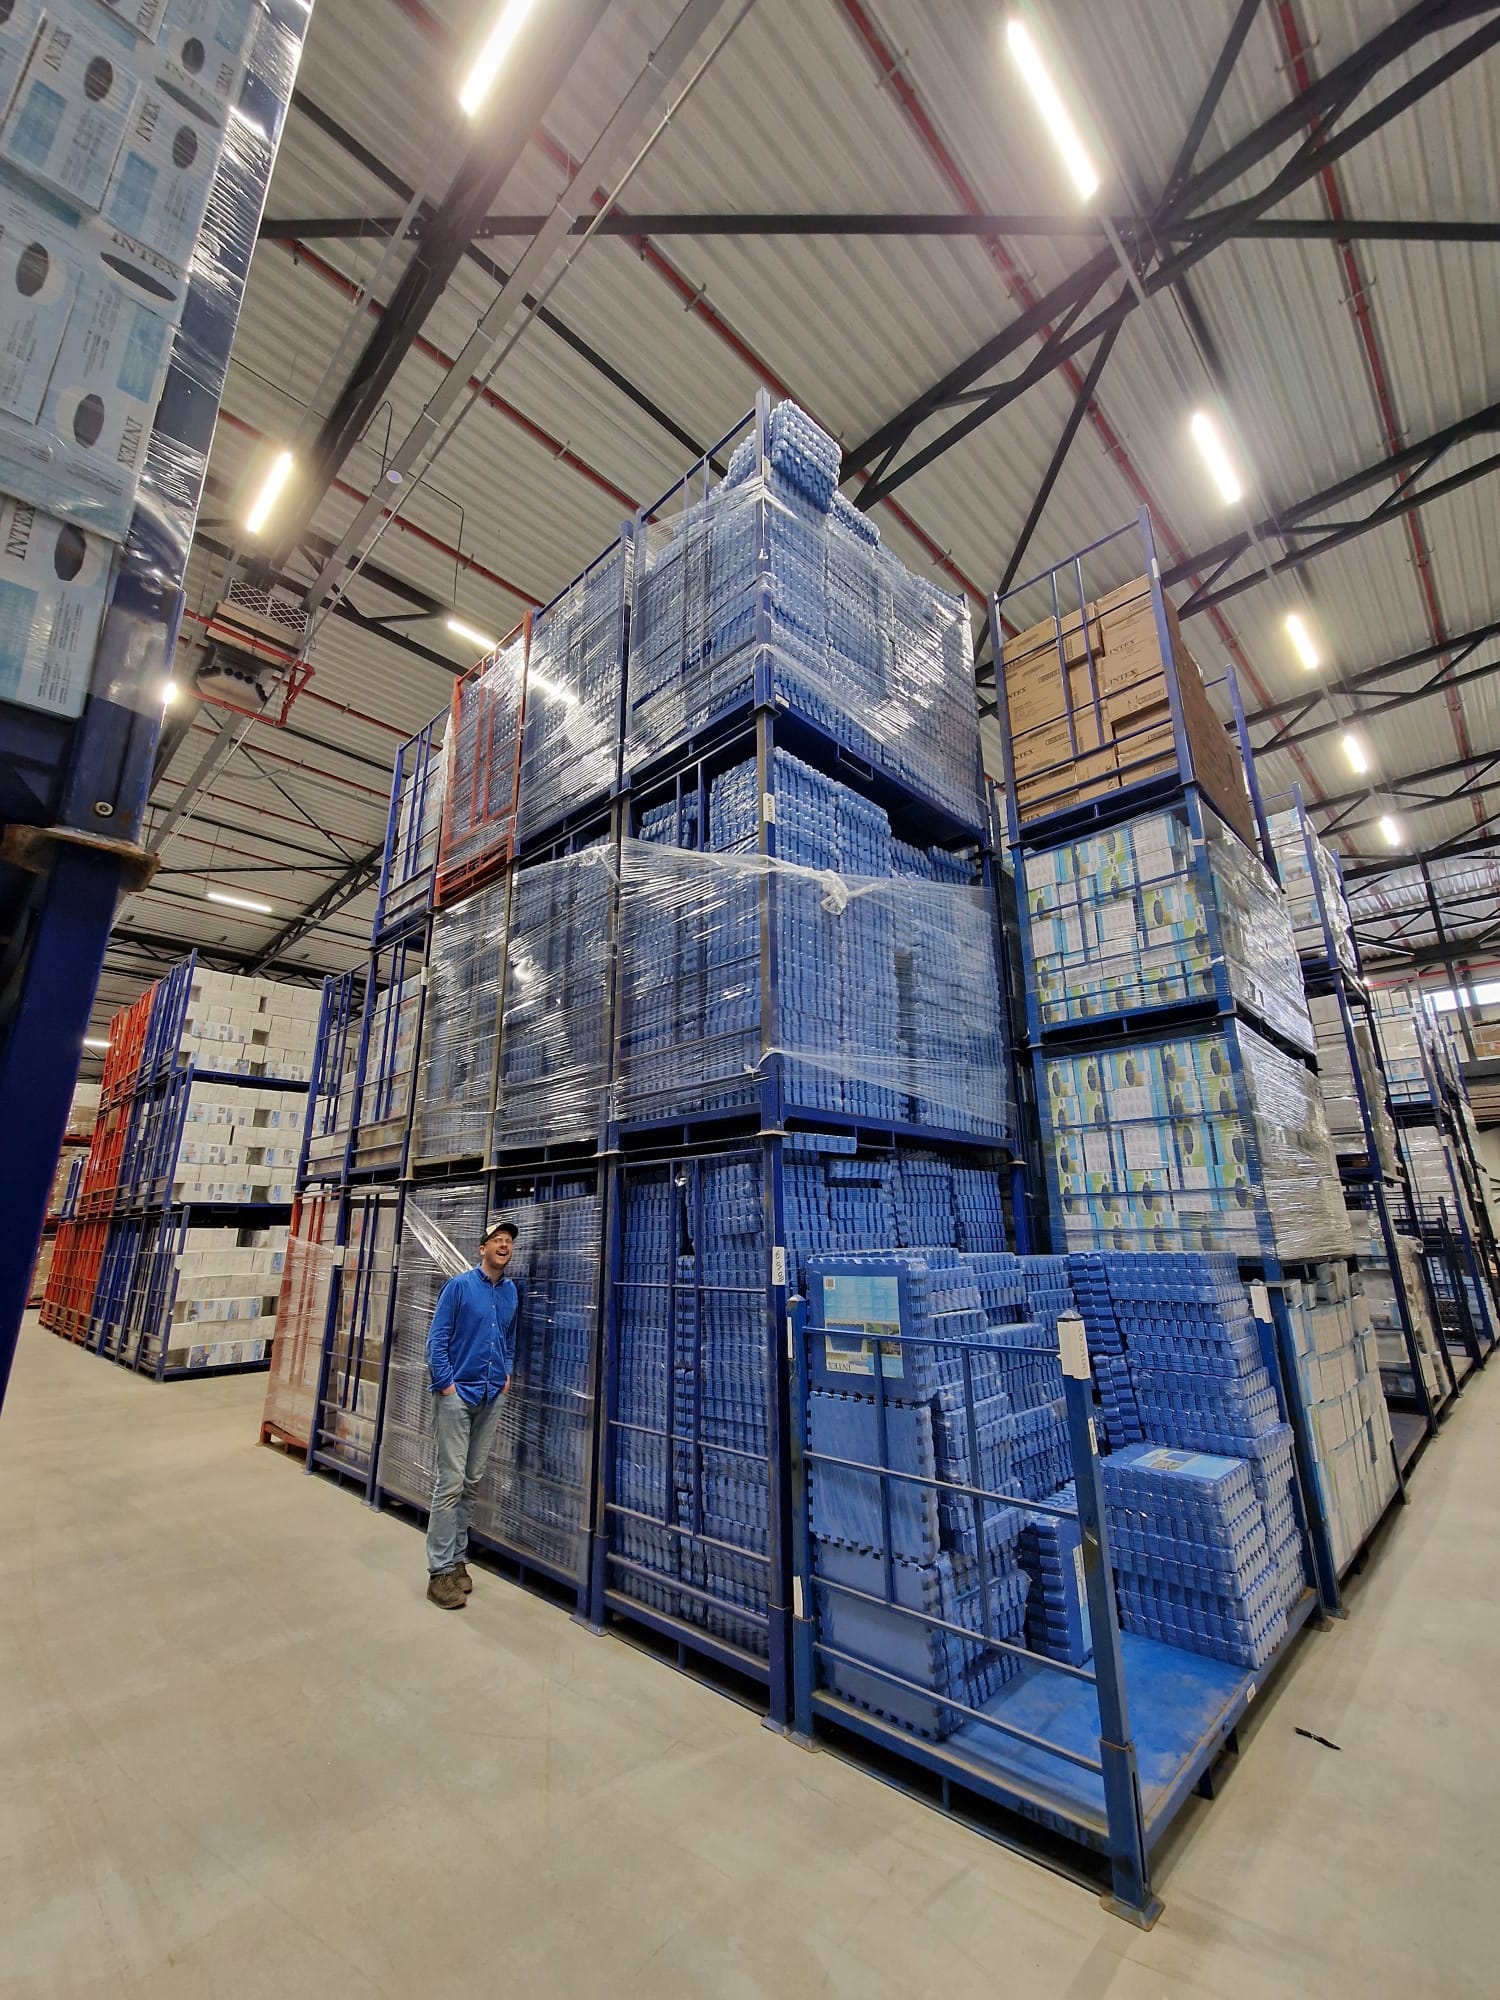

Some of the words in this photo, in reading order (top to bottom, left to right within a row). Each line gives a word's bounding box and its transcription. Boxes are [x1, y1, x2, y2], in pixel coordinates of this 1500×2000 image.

[111, 232, 178, 280] INTEX
[117, 416, 143, 469] INTEX
[5, 500, 36, 561] INTEX
[1008, 687, 1026, 699] NTEX
[1014, 749, 1034, 760] NTEX
[827, 1361, 852, 1372] INTEX
